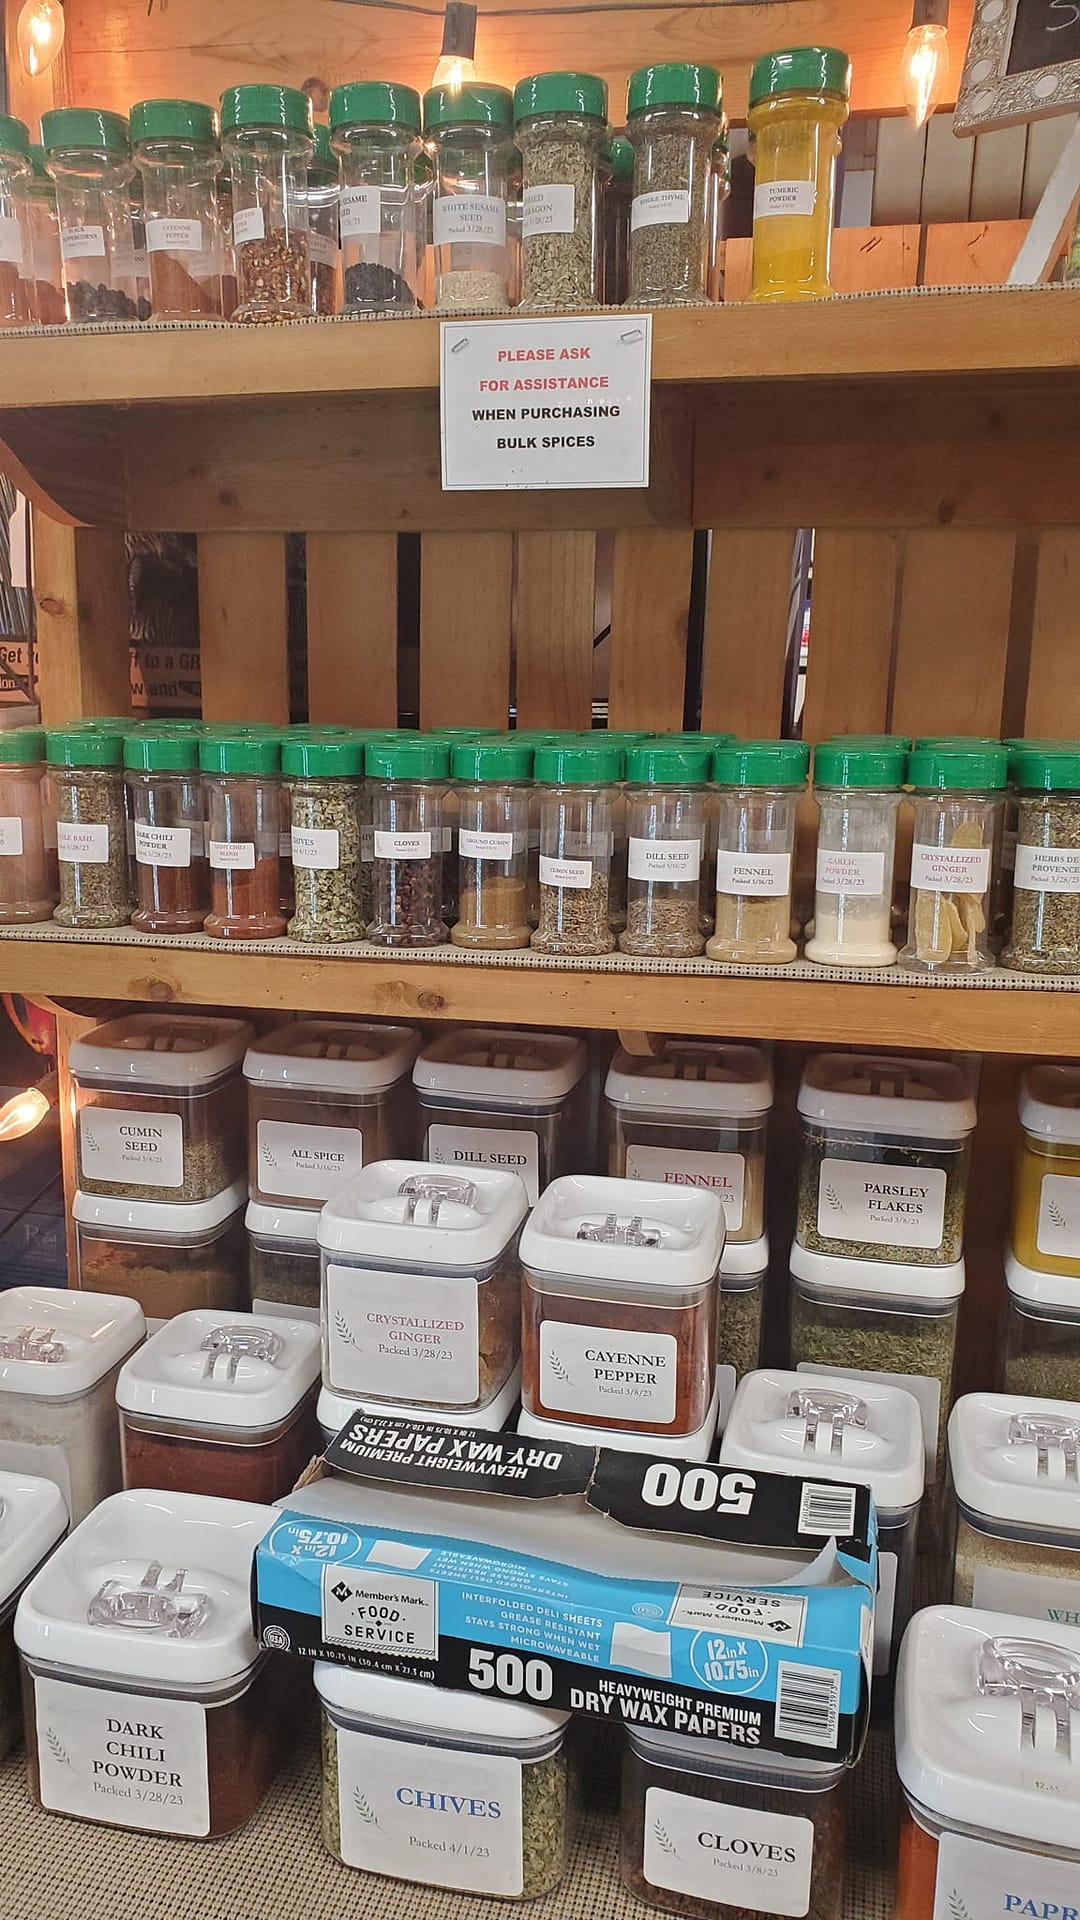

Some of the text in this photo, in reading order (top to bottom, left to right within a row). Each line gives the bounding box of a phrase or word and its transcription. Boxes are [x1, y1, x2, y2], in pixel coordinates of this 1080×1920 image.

[459, 214, 482, 222] SEED
[498, 347, 591, 362] PLEASE ASK
[479, 376, 609, 392] FOR ASSISTANCE
[472, 405, 621, 421] WHEN PURCHASING
[497, 435, 595, 449] BULK SPICES
[645, 852, 690, 861] DILL SEED
[920, 853, 982, 864] CRYSTALLIZED
[1034, 854, 1079, 864] HERBS DE
[733, 866, 774, 877] FENNEL
[825, 866, 861, 876] POWDER
[931, 865, 968, 874] GINGER
[1032, 864, 1080, 874] PROVENCE
[731, 876, 751, 885] Packed
[944, 875, 973, 884] 3/28/23
[1050, 875, 1079, 884] 3/28/23
[119, 1125, 163, 1138] CUMIN
[125, 1140, 158, 1152] SEED
[121, 1154, 142, 1163] Packed
[291, 1149, 345, 1162] ALL SPICE
[453, 1150, 527, 1166] DILL SEED
[296, 1161, 315, 1170] Packed
[664, 1172, 733, 1188] FENNEL
[864, 1182, 930, 1199] PARSLEY
[868, 1199, 923, 1214] FLAKES
[870, 1214, 920, 1225] Packed 3/8/23
[366, 1312, 465, 1332] CRYSTALLIZED
[388, 1330, 442, 1345] GINGER
[378, 1344, 453, 1361] Packed 3/28/23
[585, 1349, 667, 1367] CAYENNE
[593, 1368, 658, 1385] PEPPER
[598, 1385, 653, 1398] Packed 3/8/23
[348, 1423, 563, 1471] DRY WAX PAPERS
[340, 1437, 529, 1479] HEAVYWEIGHT PREMIUM
[641, 1463, 756, 1515] 500
[287, 1526, 349, 1545] 10.75in
[469, 1574, 493, 1584] DELI
[355, 1590, 400, 1602] Member's
[496, 1580, 569, 1600] INTERFOLDED
[702, 1590, 781, 1607] SERVICE
[357, 1605, 400, 1623] FOOD
[462, 1592, 603, 1628] INTERFOLDED DELI SHEETS
[687, 1610, 764, 1626] Member's Mark
[715, 1603, 763, 1617] FOOD
[344, 1624, 415, 1644] SERVICE
[465, 1615, 600, 1652] STAYS STRONG WHEN WET
[501, 1611, 601, 1640] GREASE RESISTANT
[510, 1635, 600, 1663] MICROWAVEABLE
[298, 1647, 306, 1656] 12
[308, 1648, 317, 1656] IN
[381, 1663, 393, 1671] cm
[419, 1669, 435, 1680] cm)
[703, 1660, 760, 1682] 10.75in
[468, 1648, 553, 1701] 500
[599, 1680, 762, 1726] HEAVYWEIGHT PREMIUM
[570, 1688, 761, 1745] DRY WAX PAPERS
[106, 1718, 165, 1740] DARK
[106, 1741, 166, 1762] CHILI
[92, 1760, 183, 1788] POWDER
[93, 1781, 184, 1806] Packed 3/28/23
[395, 1787, 502, 1820] CHIVES
[408, 1835, 491, 1859] Packed 4/1/23
[697, 1832, 797, 1864] CLOVES
[712, 1857, 779, 1878] Packed 3/8/23
[1003, 1893, 1079, 1920] PAPR
